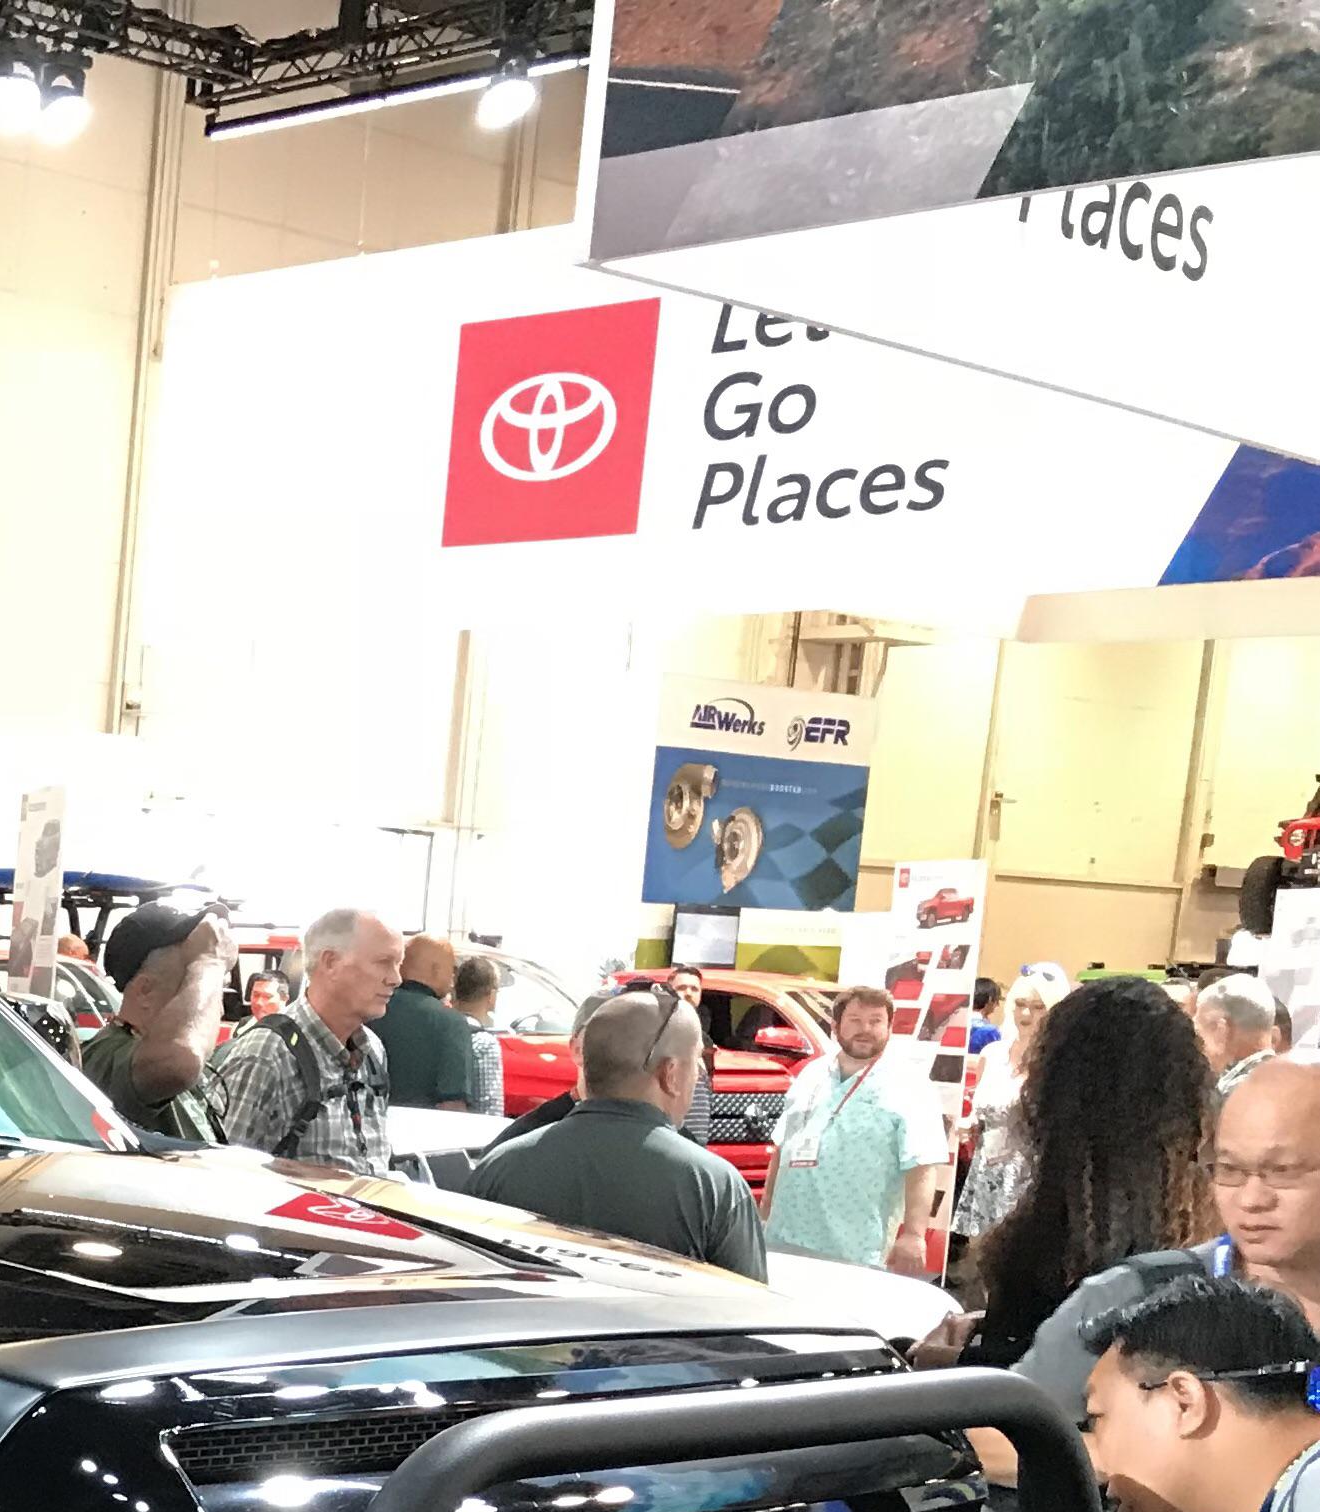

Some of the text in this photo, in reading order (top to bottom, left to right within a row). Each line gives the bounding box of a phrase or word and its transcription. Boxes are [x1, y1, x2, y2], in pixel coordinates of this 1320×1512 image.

[1019, 182, 1214, 282] laces
[711, 301, 830, 354] Le
[703, 371, 816, 441] Go
[692, 454, 950, 530] Places
[804, 716, 851, 746] EFR
